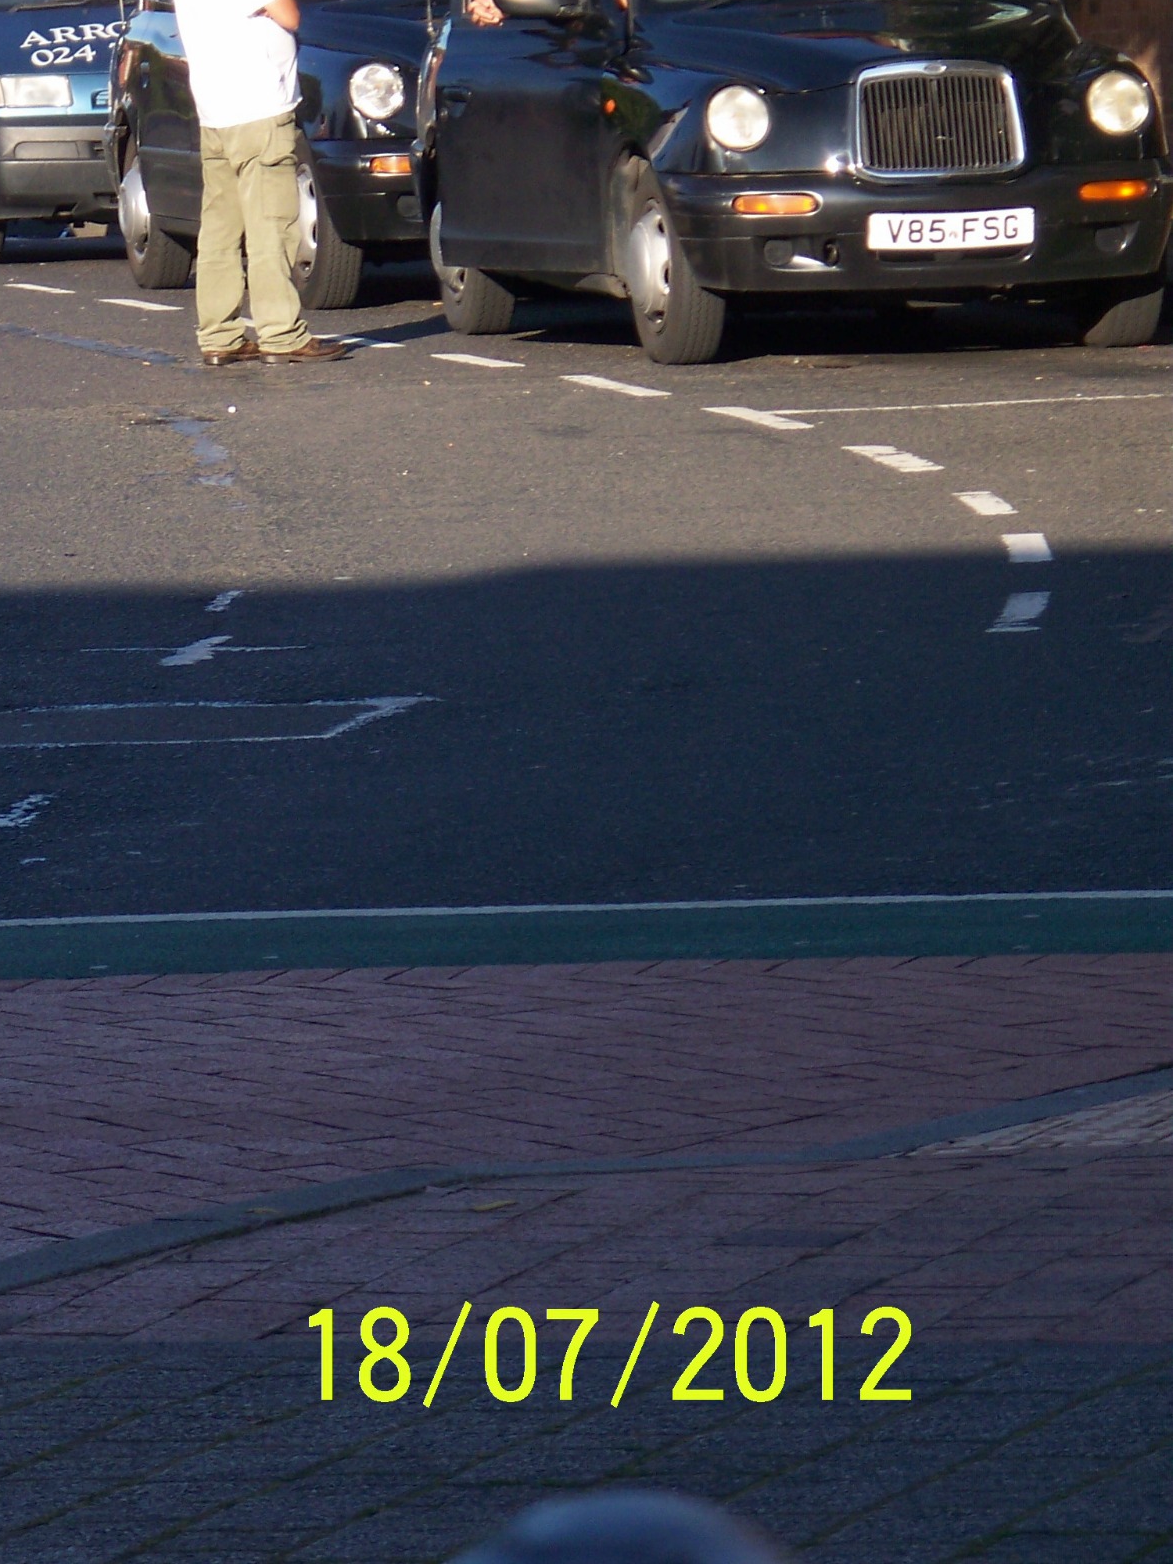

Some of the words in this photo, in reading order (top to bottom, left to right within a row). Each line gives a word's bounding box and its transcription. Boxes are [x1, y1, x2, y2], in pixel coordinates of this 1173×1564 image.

[20, 20, 127, 48] ARRO
[31, 44, 97, 66] 024
[887, 219, 946, 244] V85
[961, 214, 1019, 243] FSG
